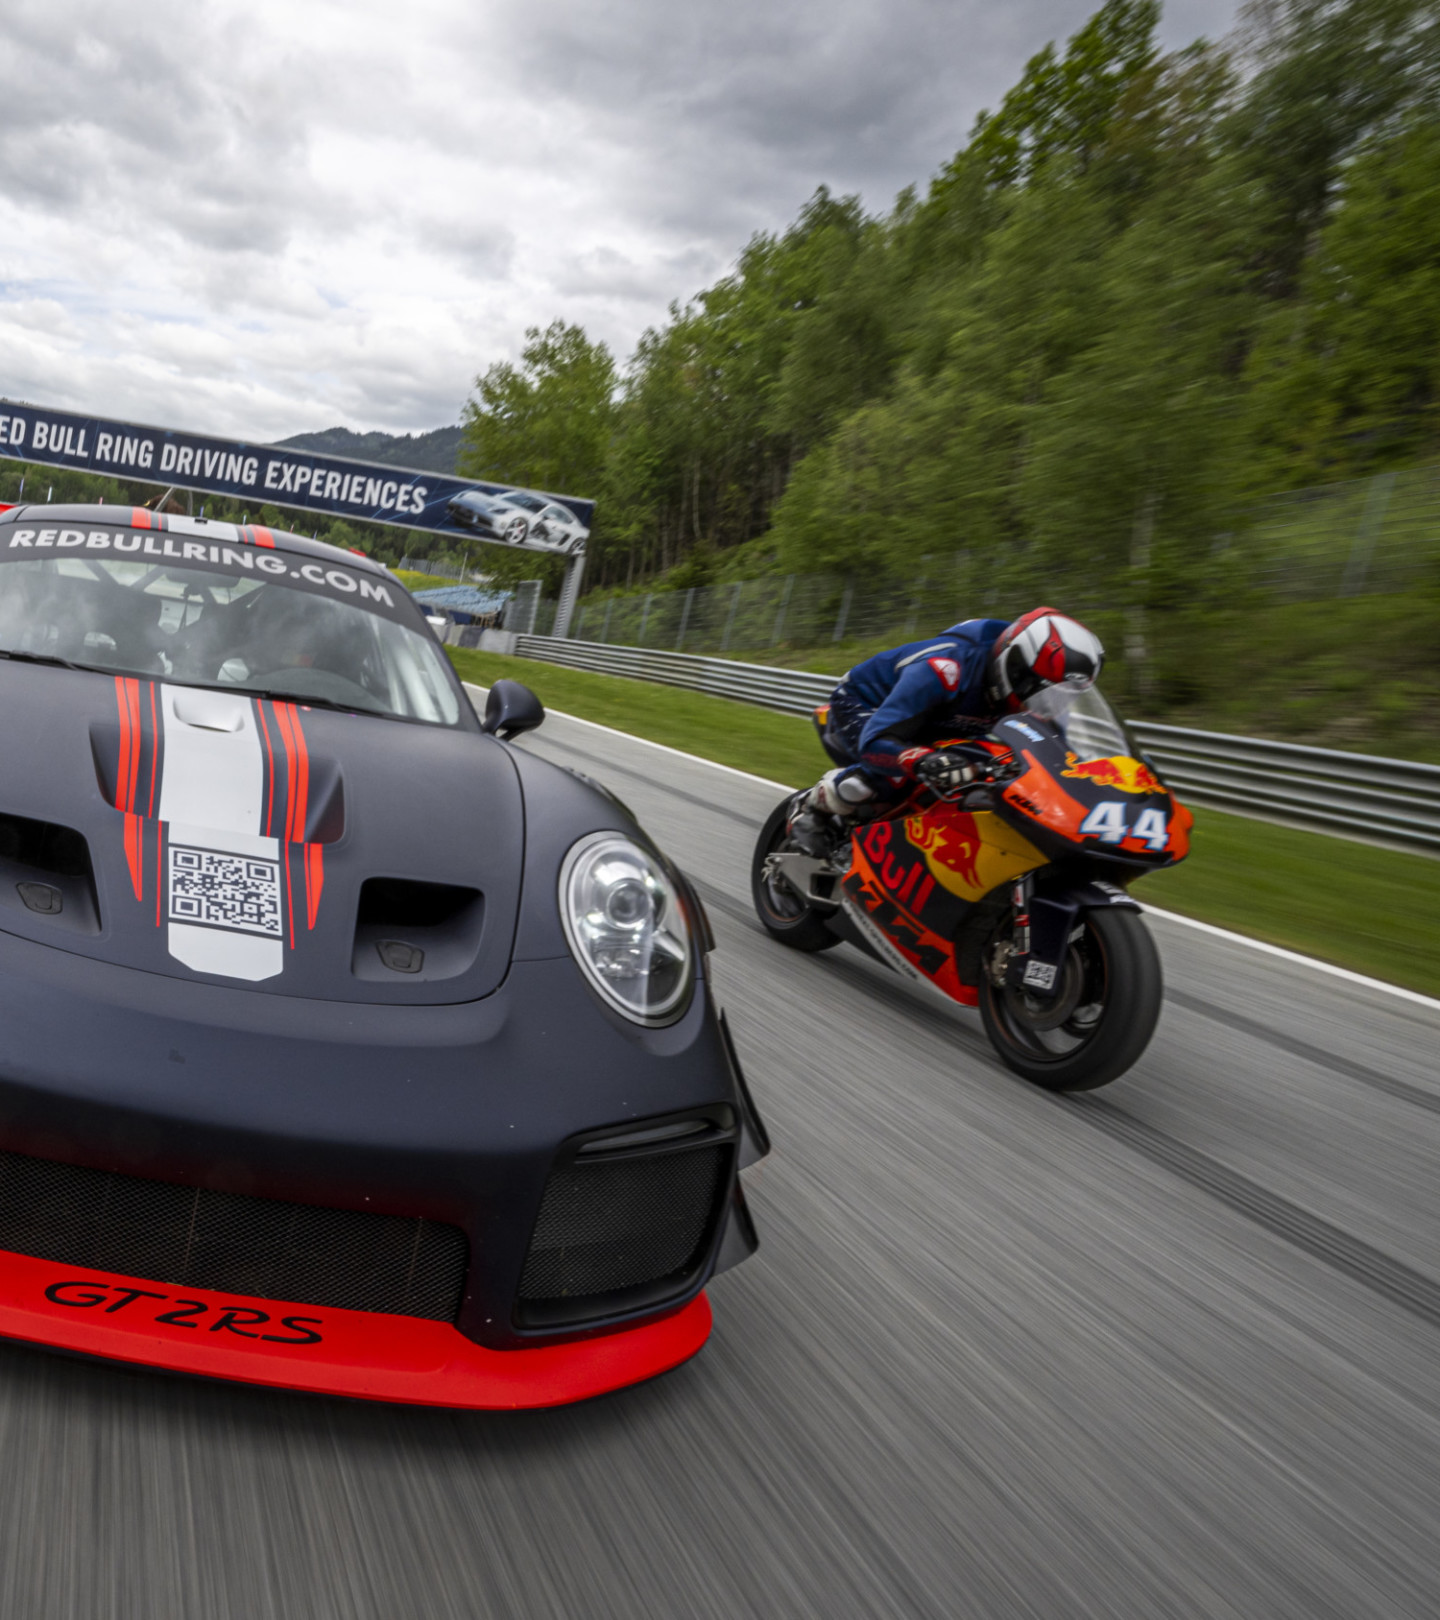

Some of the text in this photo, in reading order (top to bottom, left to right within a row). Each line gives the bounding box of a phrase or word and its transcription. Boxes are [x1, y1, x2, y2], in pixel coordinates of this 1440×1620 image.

[32, 421, 89, 458] BULL
[95, 432, 154, 469] RING
[160, 443, 259, 486] DRIVING
[264, 460, 428, 515] EXPERIENCES
[9, 529, 395, 608] REDBULLRING.COM
[863, 821, 936, 916] Bull
[1079, 801, 1171, 851] 44
